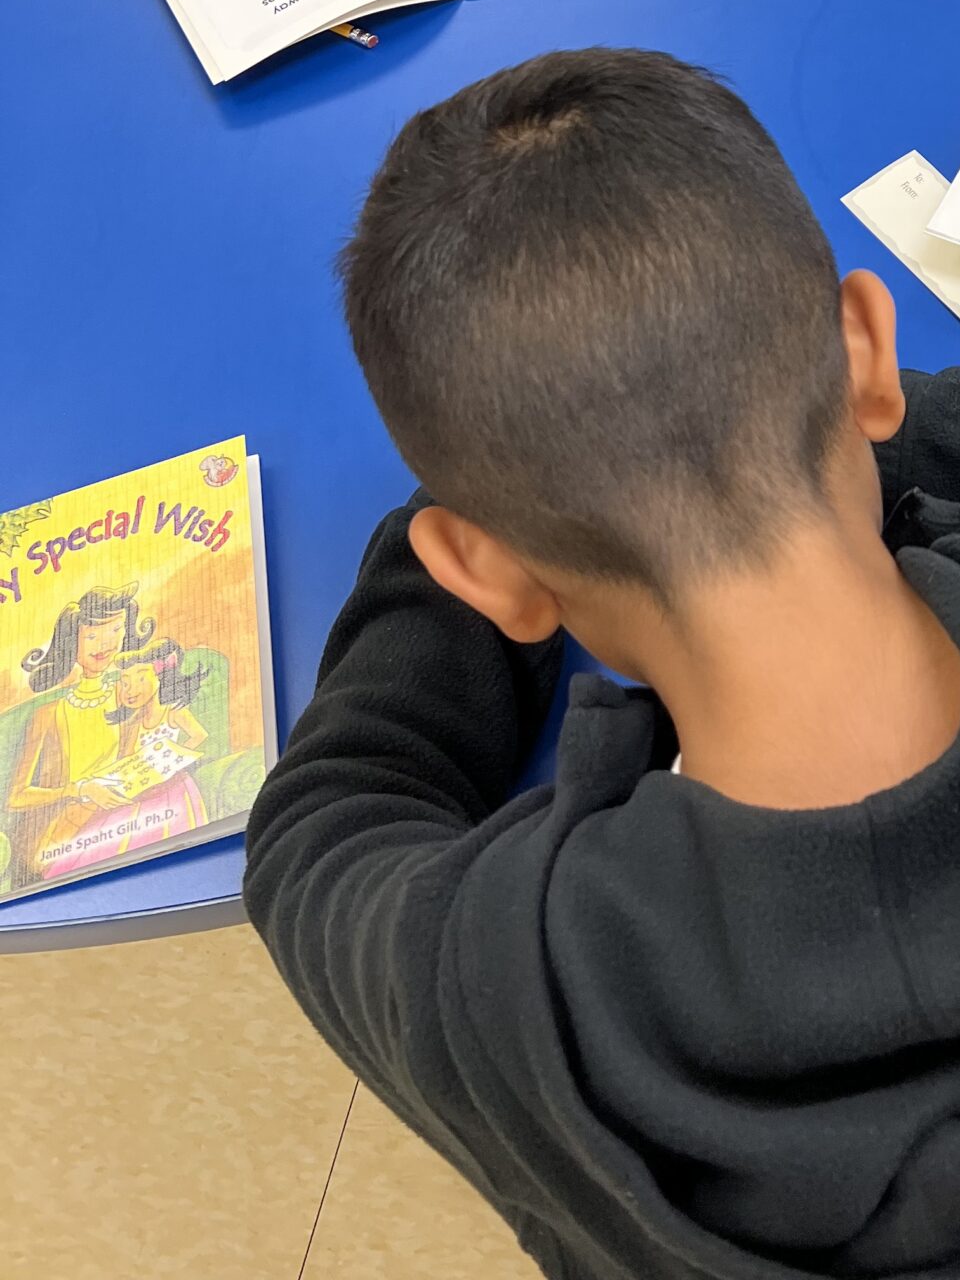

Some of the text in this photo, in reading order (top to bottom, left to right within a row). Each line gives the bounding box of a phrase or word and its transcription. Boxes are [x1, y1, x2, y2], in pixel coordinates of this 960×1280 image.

[26, 495, 146, 575] Special
[154, 501, 234, 552] Wish
[40, 808, 179, 862] Janie Spaht Gill, Ph.D.
